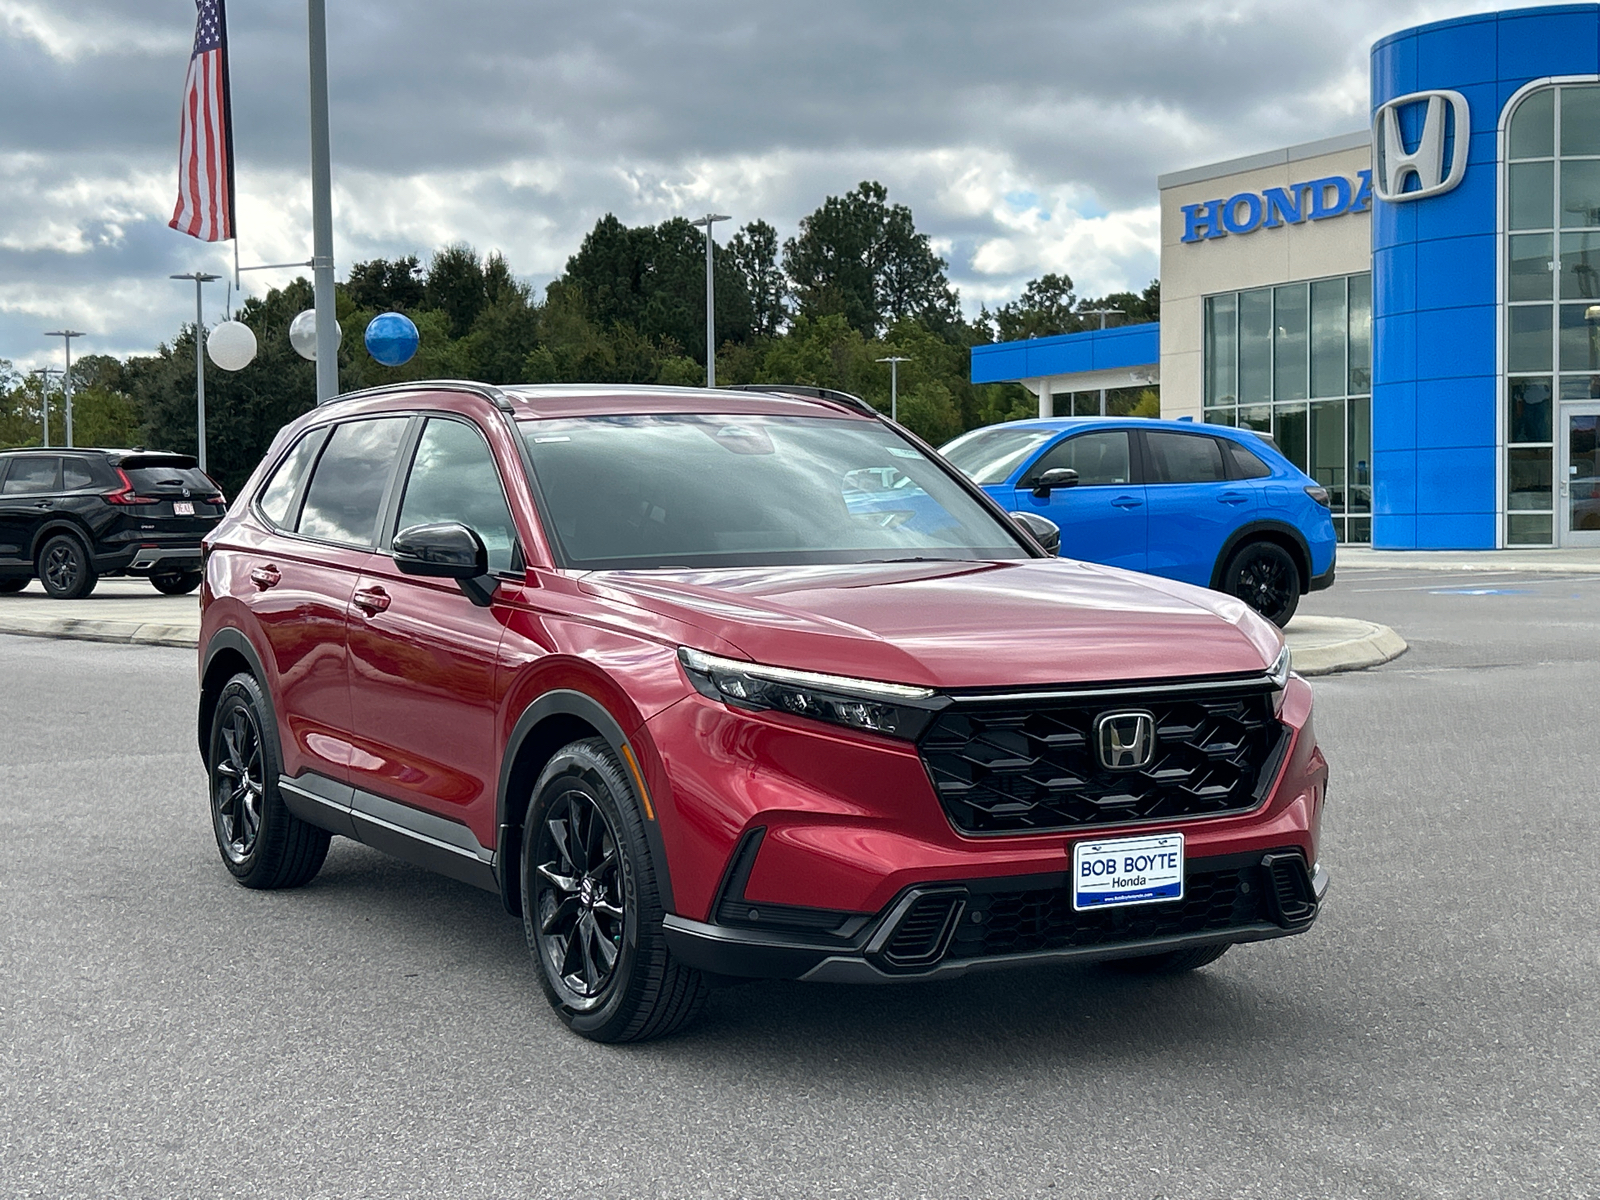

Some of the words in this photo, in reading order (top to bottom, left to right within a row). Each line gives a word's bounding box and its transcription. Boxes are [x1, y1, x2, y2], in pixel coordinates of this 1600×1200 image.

[1081, 858, 1117, 878] BOB
[1123, 852, 1178, 873] BOYTE
[1111, 875, 1147, 889] Honda
